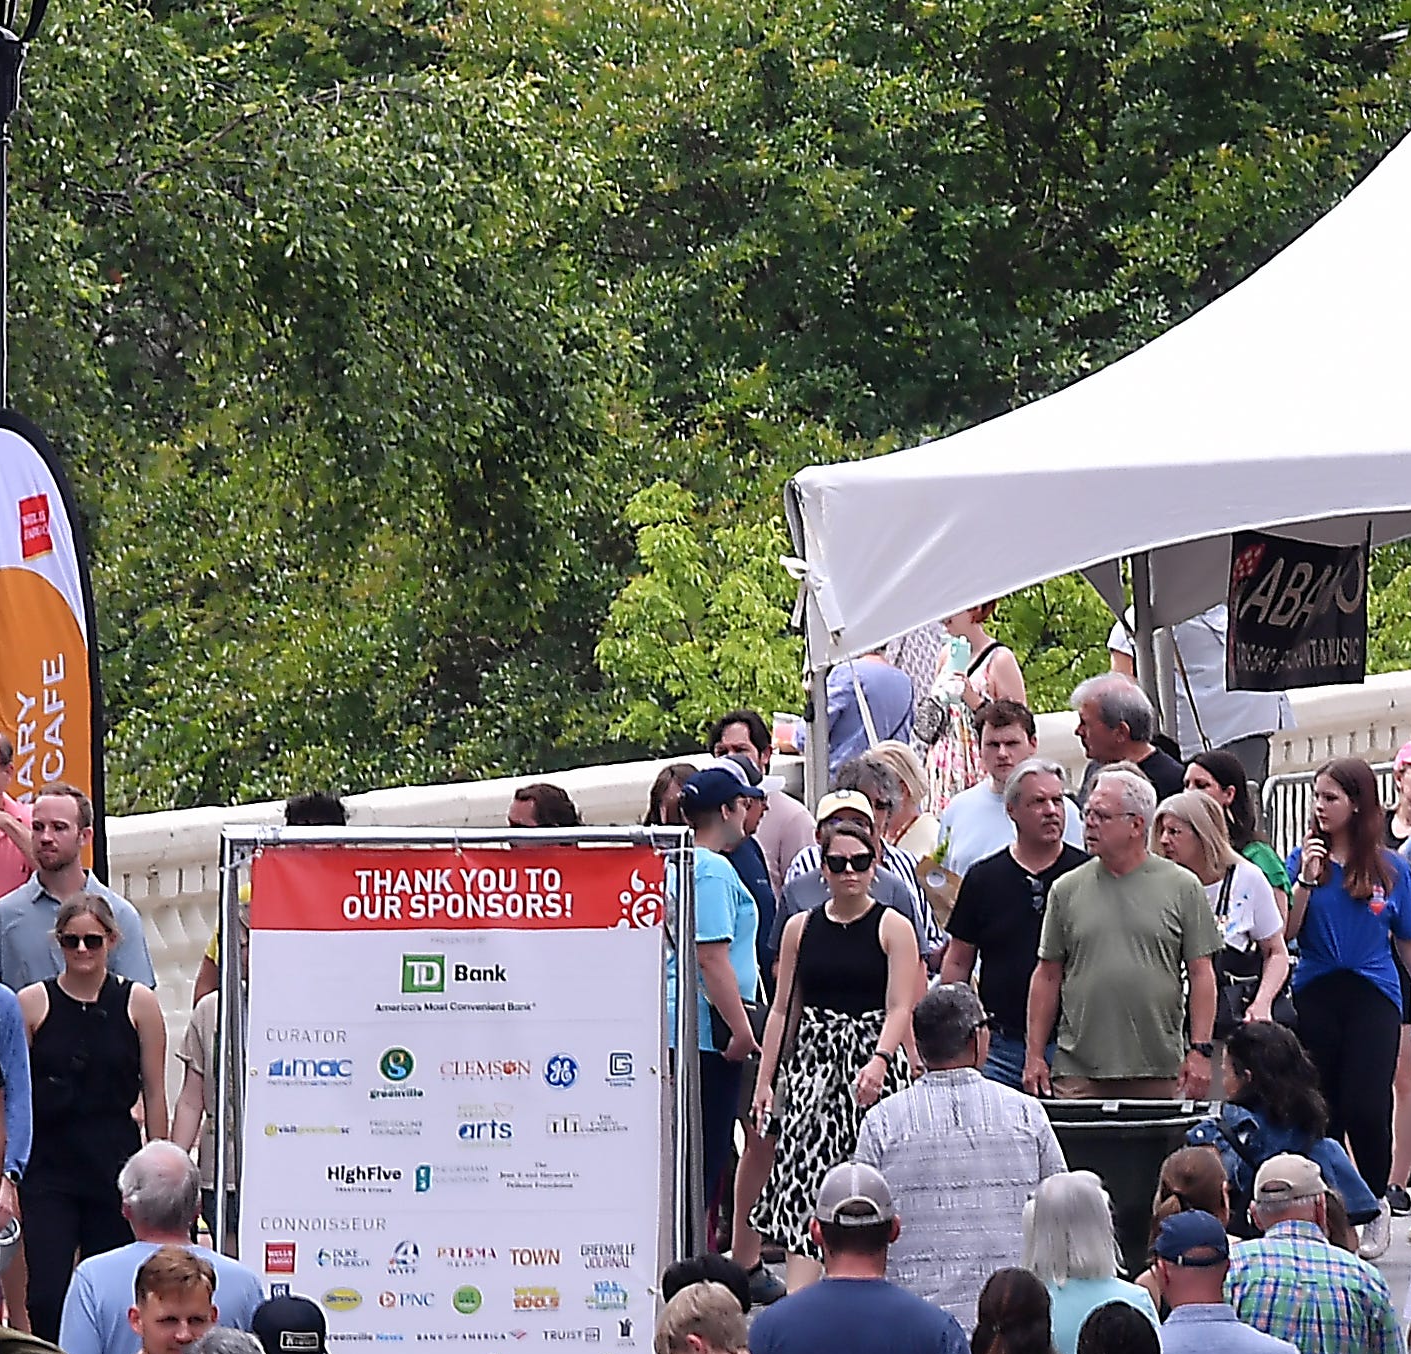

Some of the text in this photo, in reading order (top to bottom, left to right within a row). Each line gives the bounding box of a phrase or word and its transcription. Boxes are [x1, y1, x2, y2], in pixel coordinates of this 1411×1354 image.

[41, 653, 66, 783] CAFE
[354, 868, 562, 895] THANK YOU TO
[342, 893, 573, 920] OUR SPONSORS!
[406, 961, 442, 986] TD
[454, 964, 507, 982] Bank
[375, 1002, 422, 1012] America's
[424, 1002, 448, 1011] Most
[449, 1001, 506, 1012] Convenient
[266, 1028, 347, 1043] CURATOR
[458, 1119, 513, 1140] arts
[327, 1165, 402, 1184] HighFive
[260, 1216, 387, 1231] CONNOISSEUR
[437, 1247, 497, 1259] PRISMA
[509, 1248, 561, 1266] TOWN
[580, 1243, 636, 1256] GREENVILLE
[584, 1256, 630, 1269] JOURNAL
[399, 1293, 435, 1307] PNC
[416, 1333, 443, 1341] BANK
[462, 1332, 507, 1341] AMERICA
[543, 1329, 582, 1341] TRUIST
